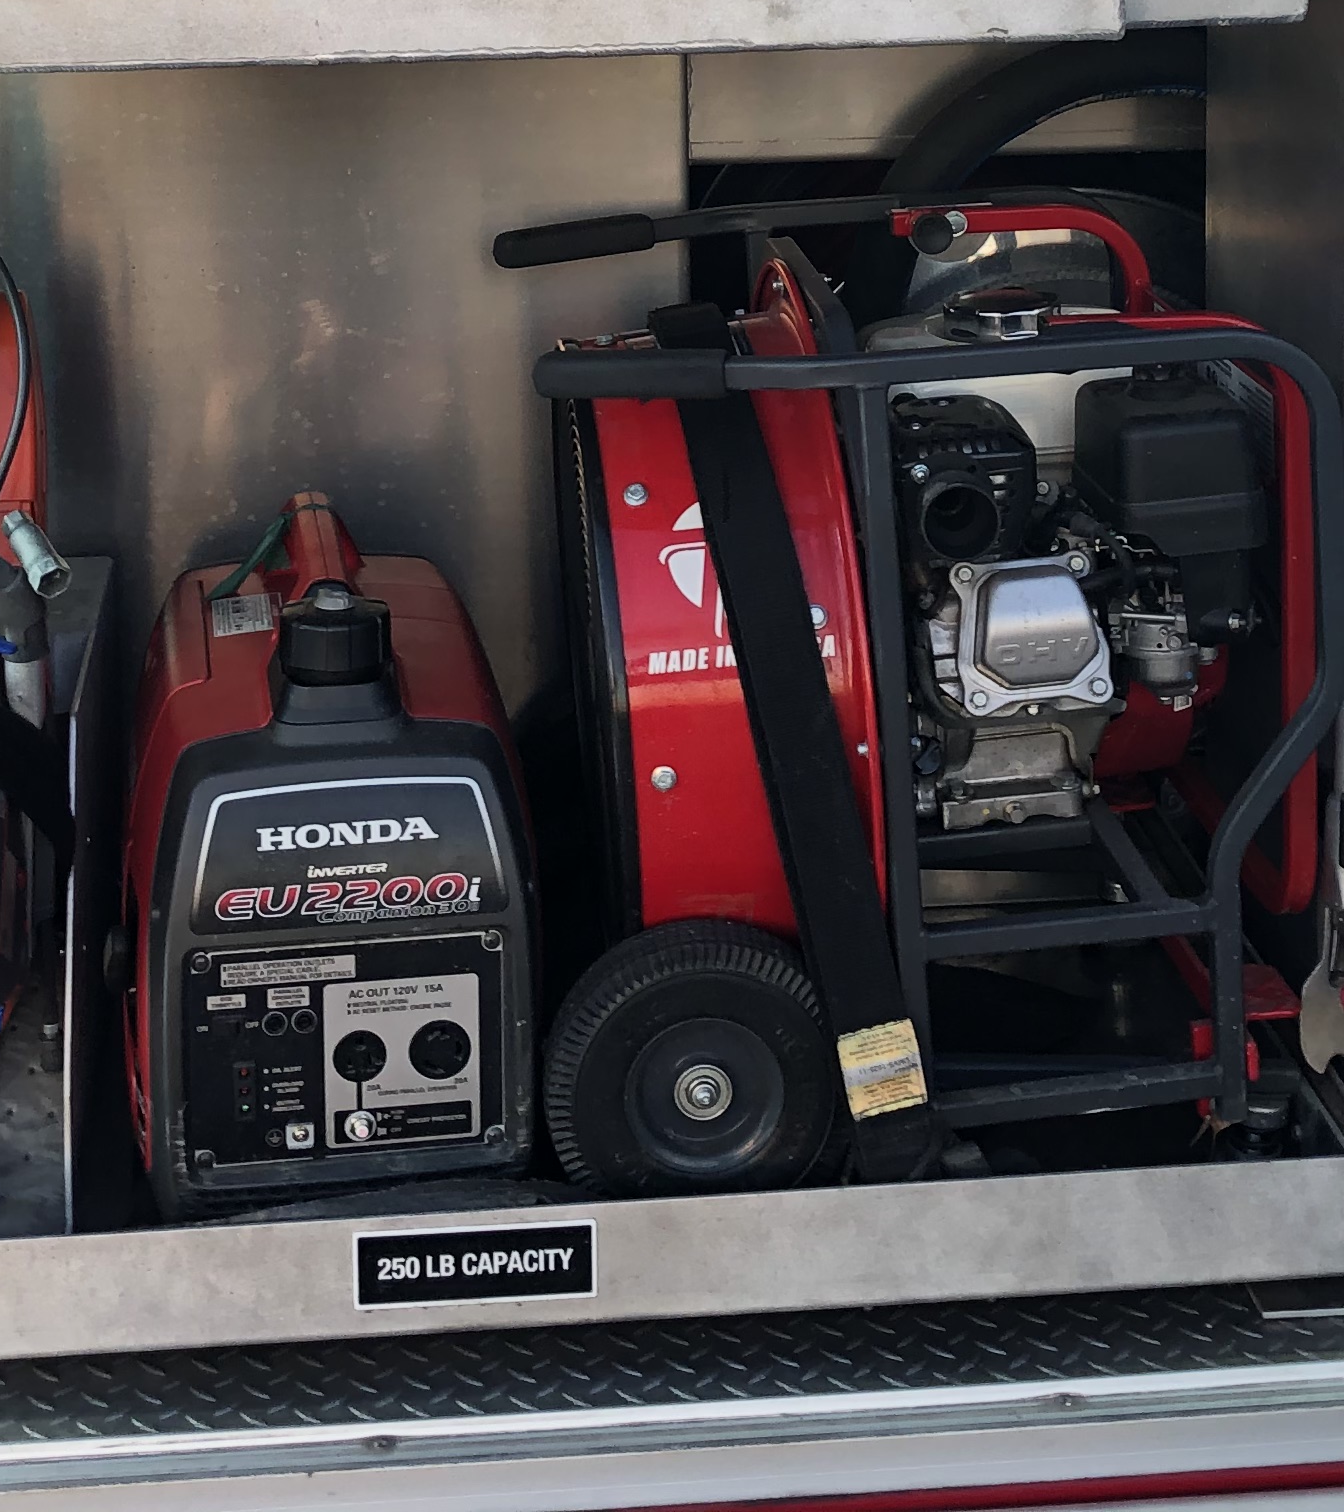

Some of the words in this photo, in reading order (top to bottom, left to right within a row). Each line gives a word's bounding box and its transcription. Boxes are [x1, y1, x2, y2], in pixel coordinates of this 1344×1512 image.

[647, 647, 710, 675] MADE
[996, 637, 1089, 665] OHV
[256, 816, 439, 852] HONDA
[215, 872, 482, 921] EU2200i
[317, 904, 436, 924] Companion
[349, 989, 364, 999] AC
[366, 987, 391, 998] OUT
[393, 985, 418, 995] 120V
[424, 983, 444, 993] 15A
[377, 1256, 420, 1281] 250
[425, 1254, 456, 1278] LB
[461, 1247, 574, 1276] CAPACITY
